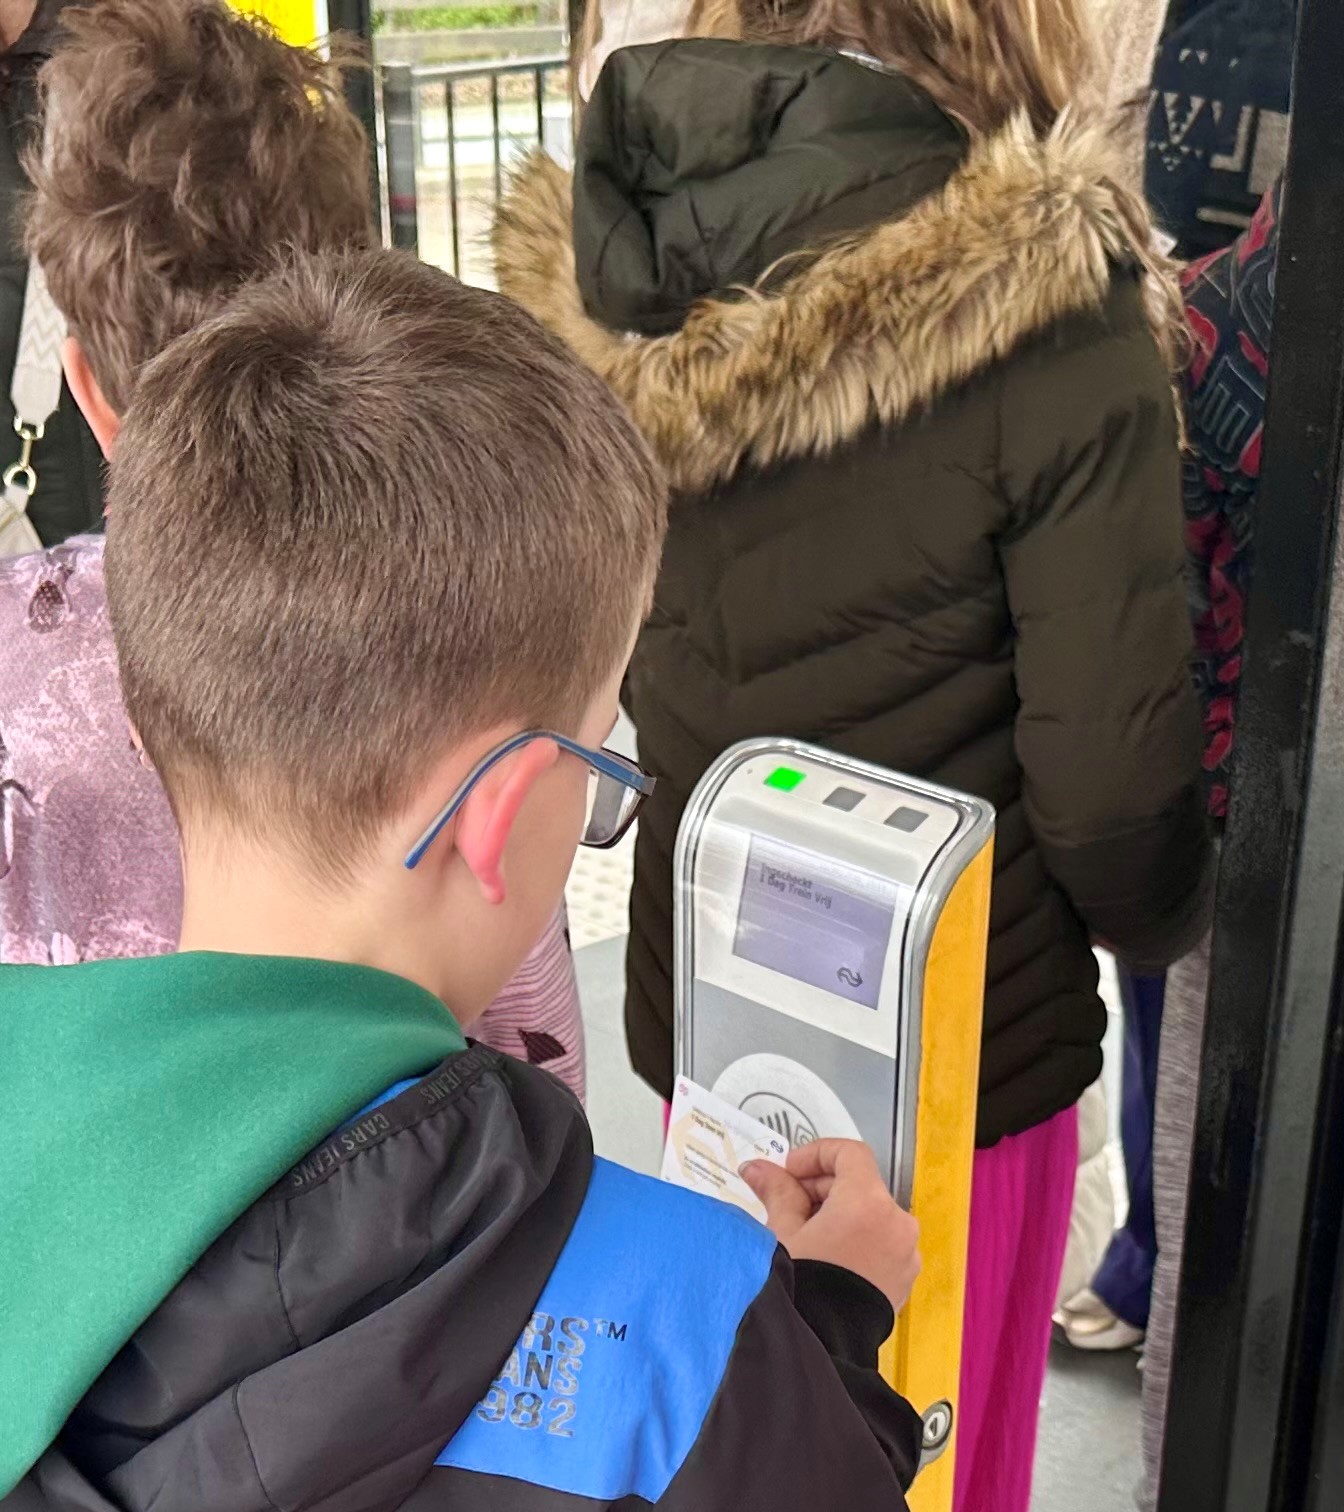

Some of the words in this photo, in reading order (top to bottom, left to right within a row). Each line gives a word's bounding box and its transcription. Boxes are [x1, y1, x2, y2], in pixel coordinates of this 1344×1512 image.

[341, 1112, 391, 1151] CARS
[521, 1311, 590, 1357] RS
[495, 1347, 583, 1396] ANS
[475, 1385, 578, 1438] 982
